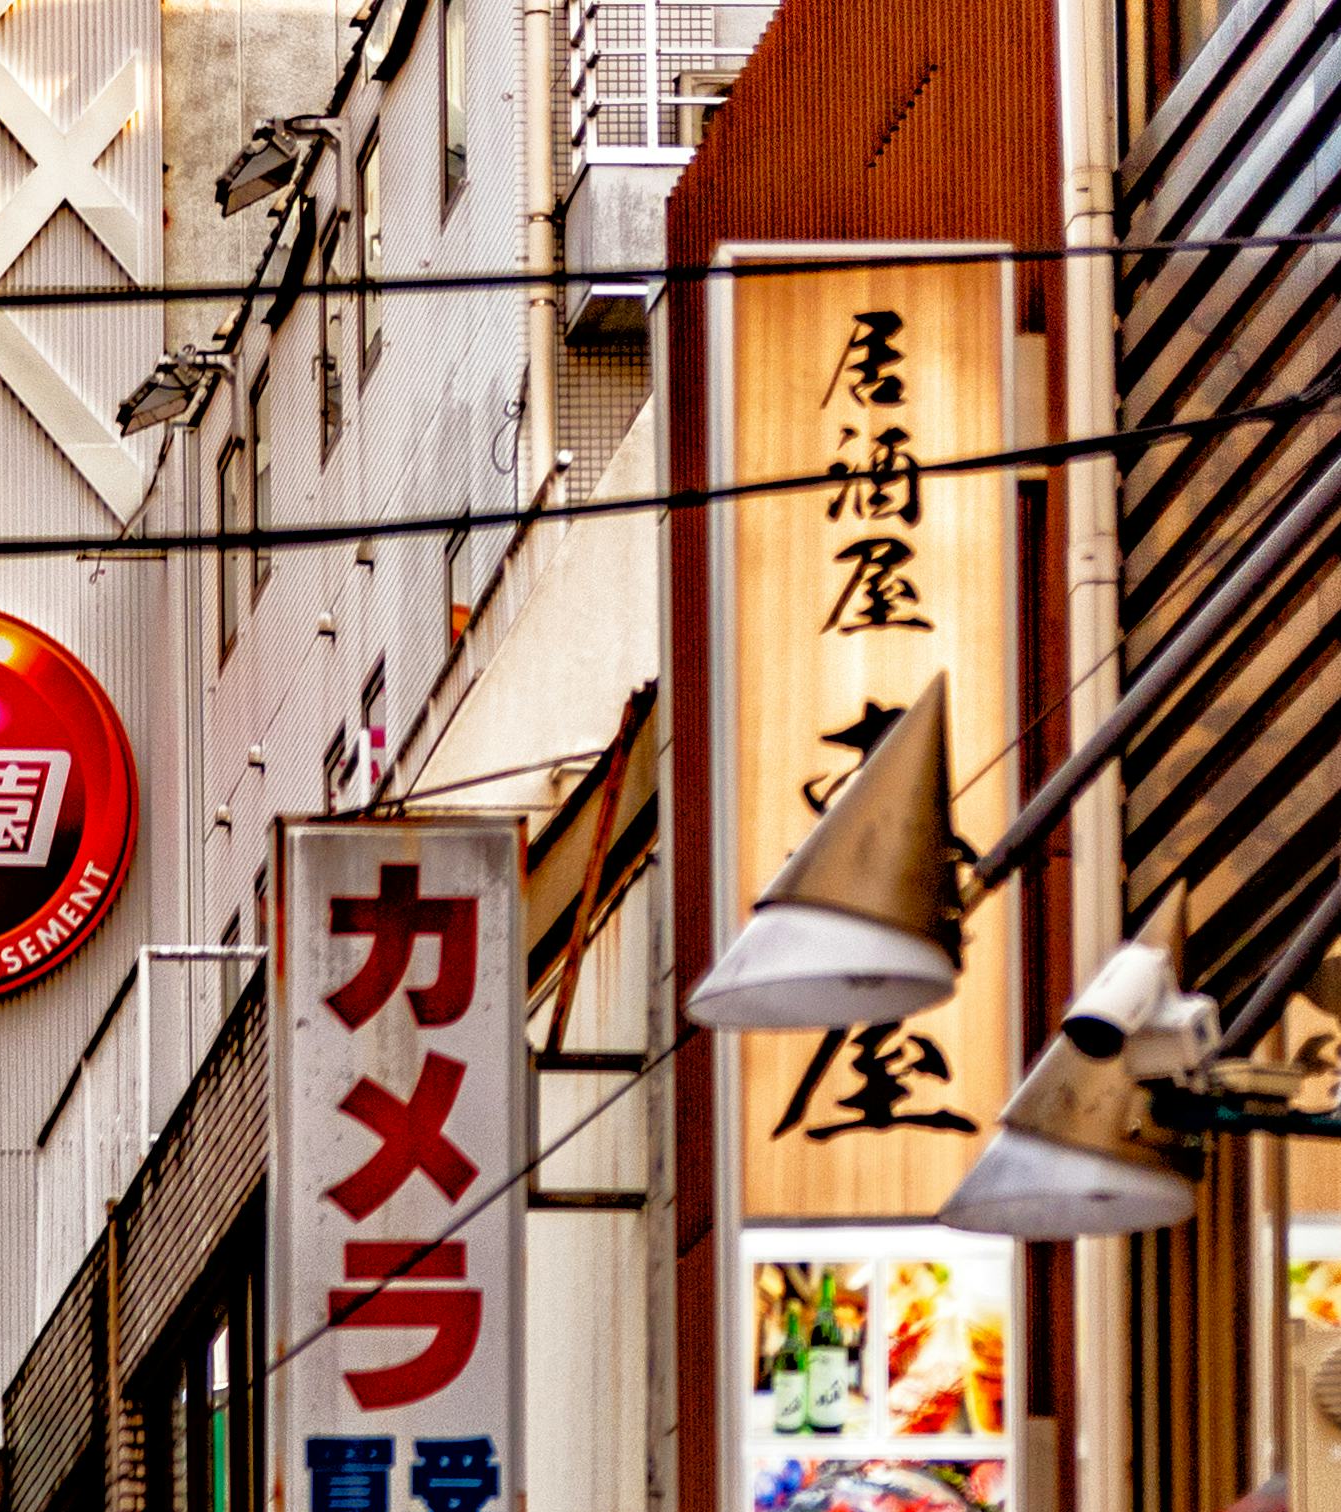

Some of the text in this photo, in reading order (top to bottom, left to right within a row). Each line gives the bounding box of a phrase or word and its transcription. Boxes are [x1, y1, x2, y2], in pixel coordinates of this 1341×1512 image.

[820, 310, 934, 632] 居酒屋
[325, 862, 484, 1412] カメラ
